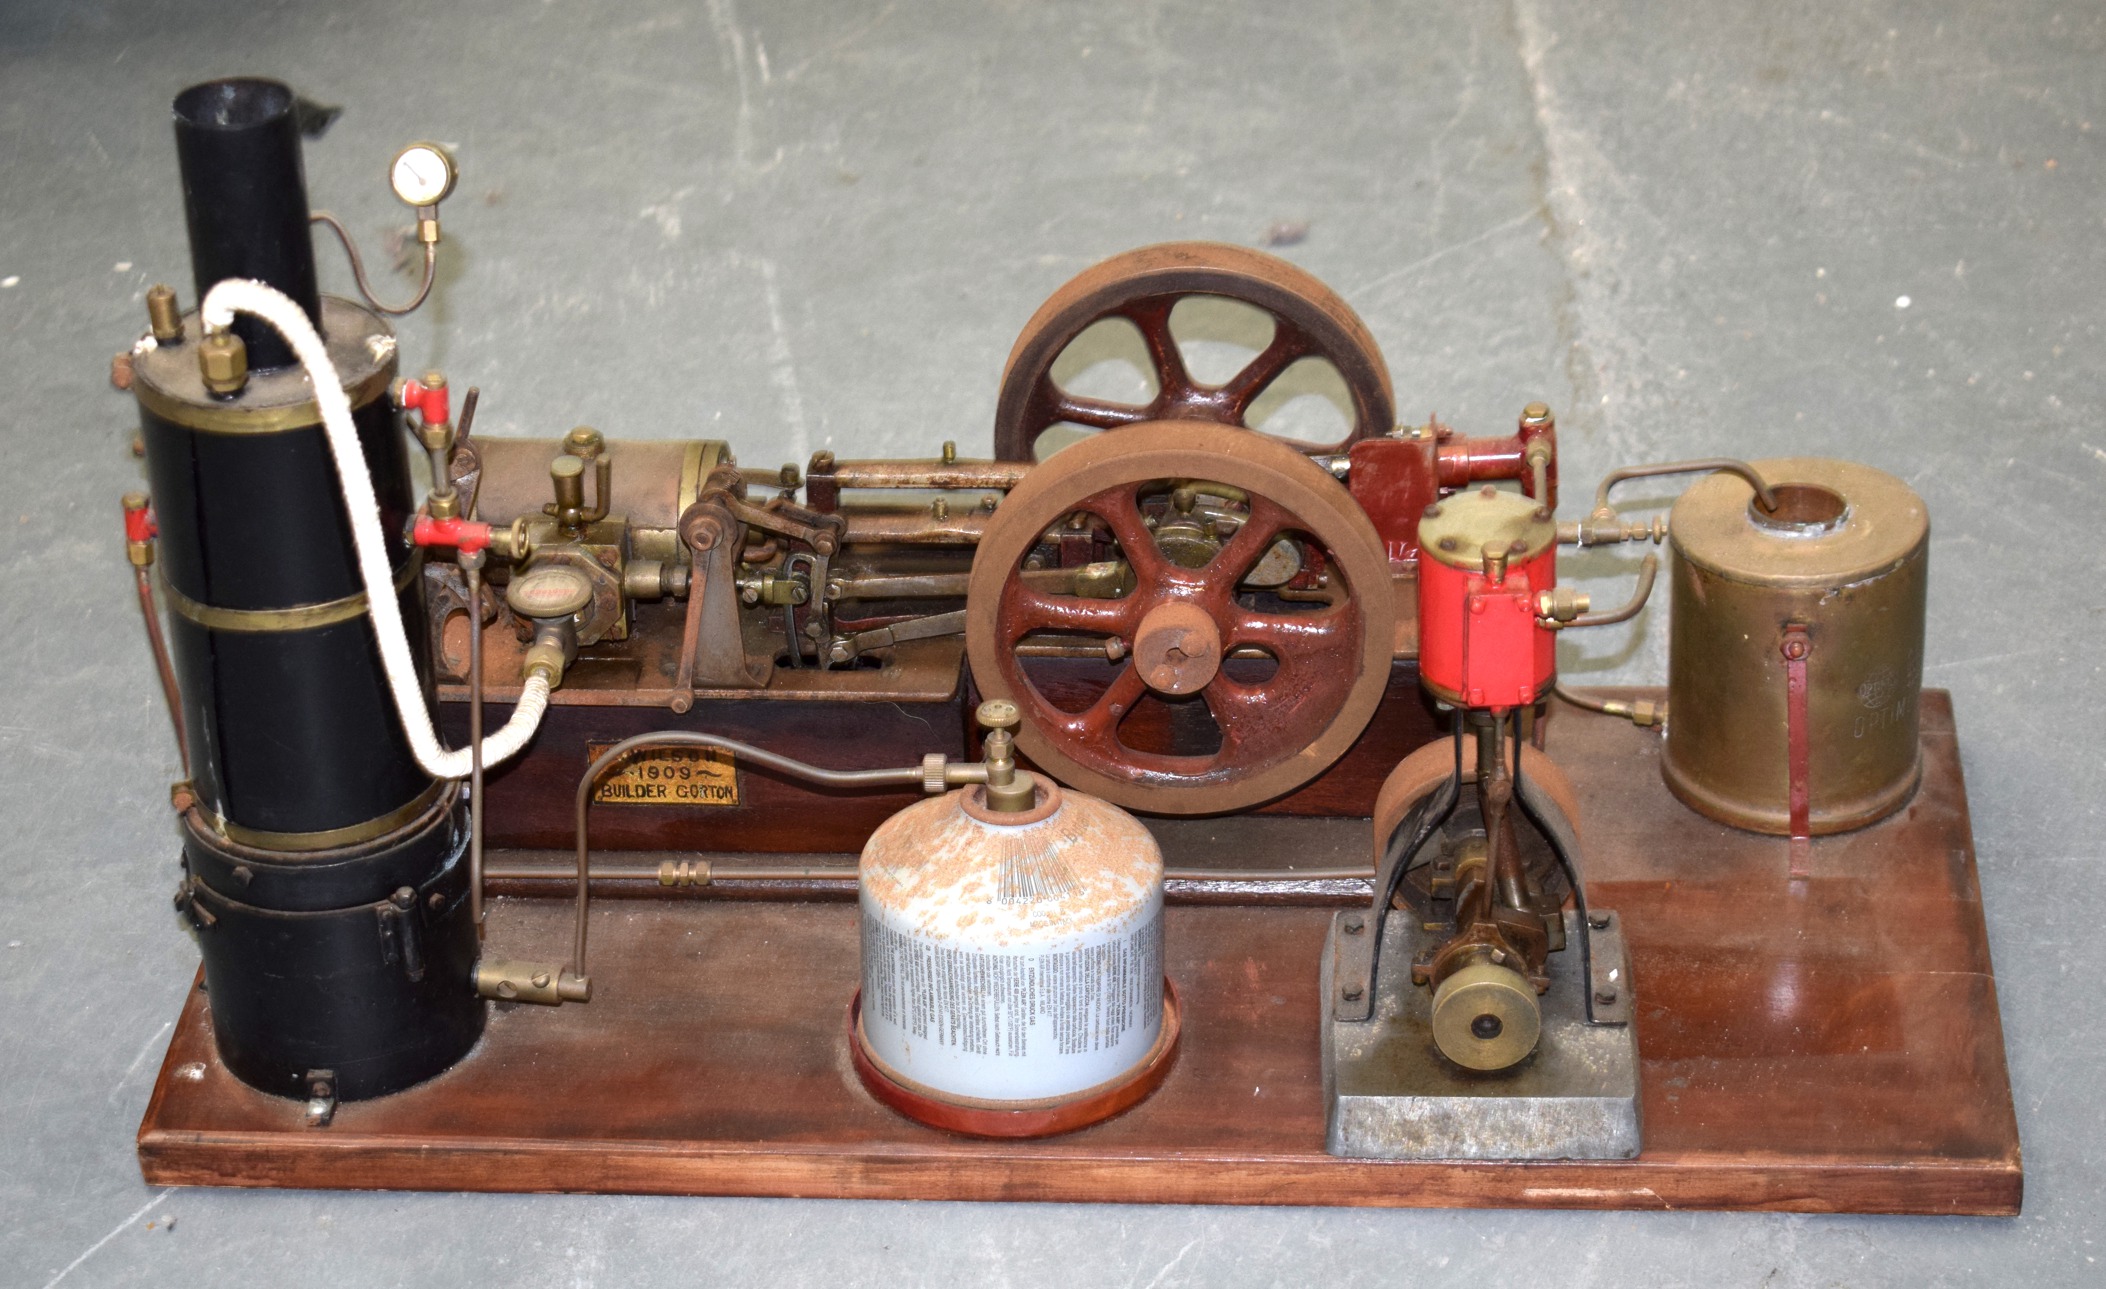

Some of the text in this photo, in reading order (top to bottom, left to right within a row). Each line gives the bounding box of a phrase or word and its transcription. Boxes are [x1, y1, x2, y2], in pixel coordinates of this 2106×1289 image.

[639, 766, 691, 780] 1909
[601, 784, 733, 799] BUILDER GORTON
